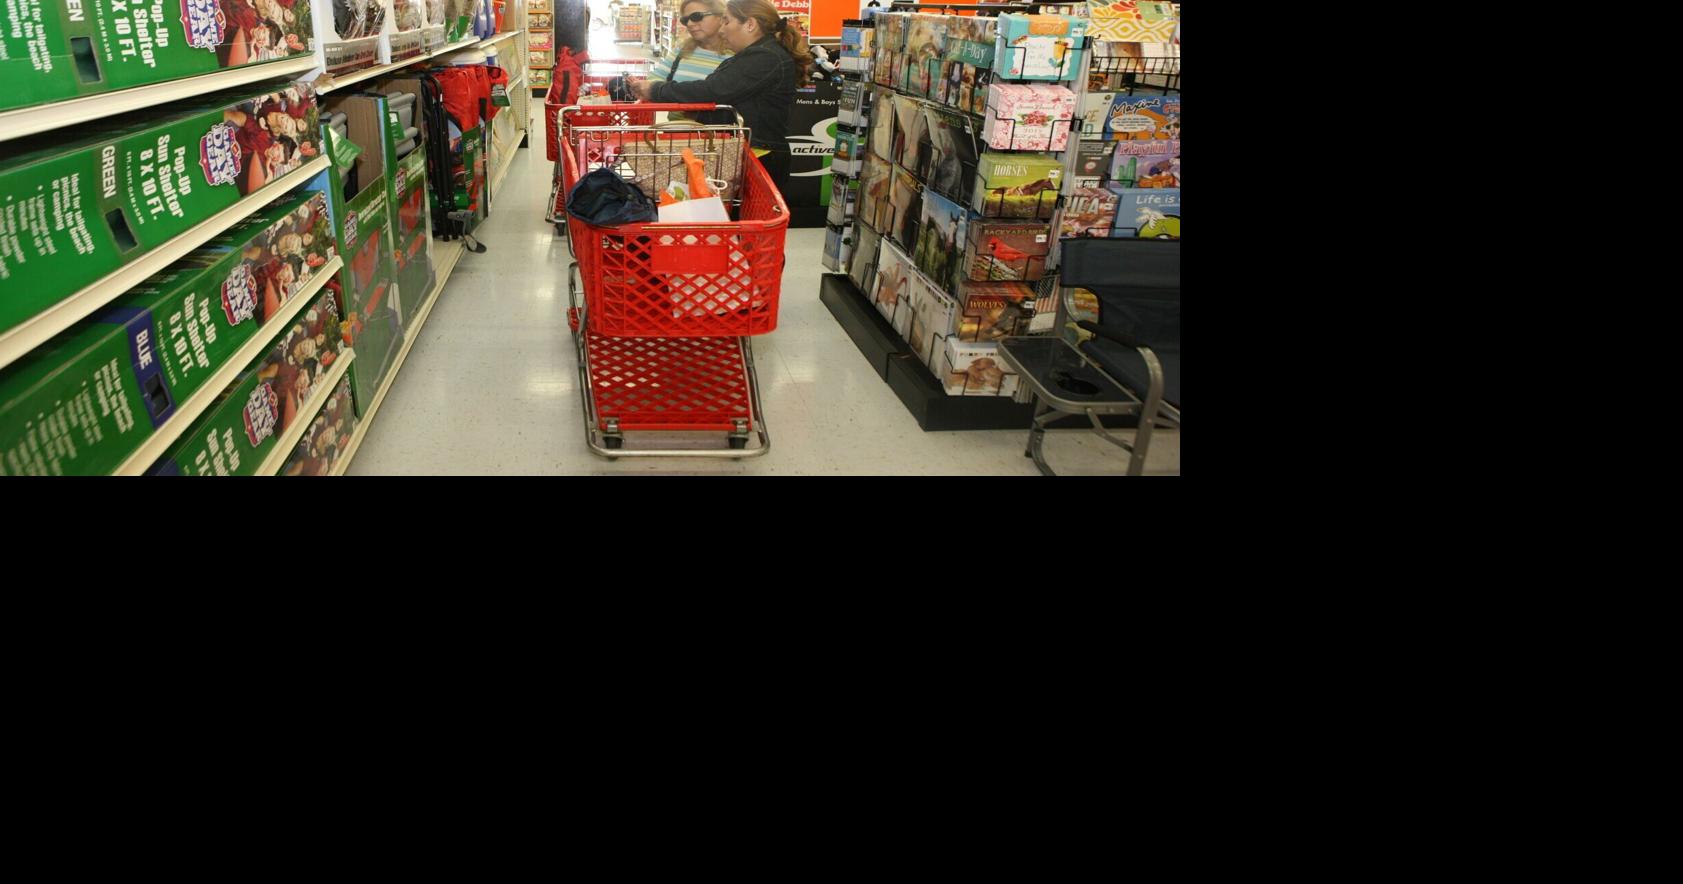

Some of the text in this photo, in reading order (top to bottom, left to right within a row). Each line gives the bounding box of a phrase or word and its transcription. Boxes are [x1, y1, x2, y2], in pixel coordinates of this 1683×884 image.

[782, 0, 809, 8] Debb
[114, 17, 131, 35] 10
[133, 9, 156, 68] Shelter
[118, 39, 137, 62] FT.
[1110, 98, 1160, 117] Maxine
[174, 145, 192, 196] Pop-Up
[211, 123, 235, 185] DAY
[792, 144, 835, 154] active
[993, 164, 1028, 177] HORSES
[102, 145, 116, 199] GREEN
[140, 149, 165, 220] 8 X 10 FT.
[157, 134, 184, 218] Sun Shelter
[1136, 195, 1176, 204] Life is
[199, 297, 217, 344] Pop-Up
[970, 300, 1004, 309] WOLVES
[136, 329, 152, 370] BLUE
[184, 292, 210, 368] Sun Shelter
[223, 427, 240, 472] Pop-Up
